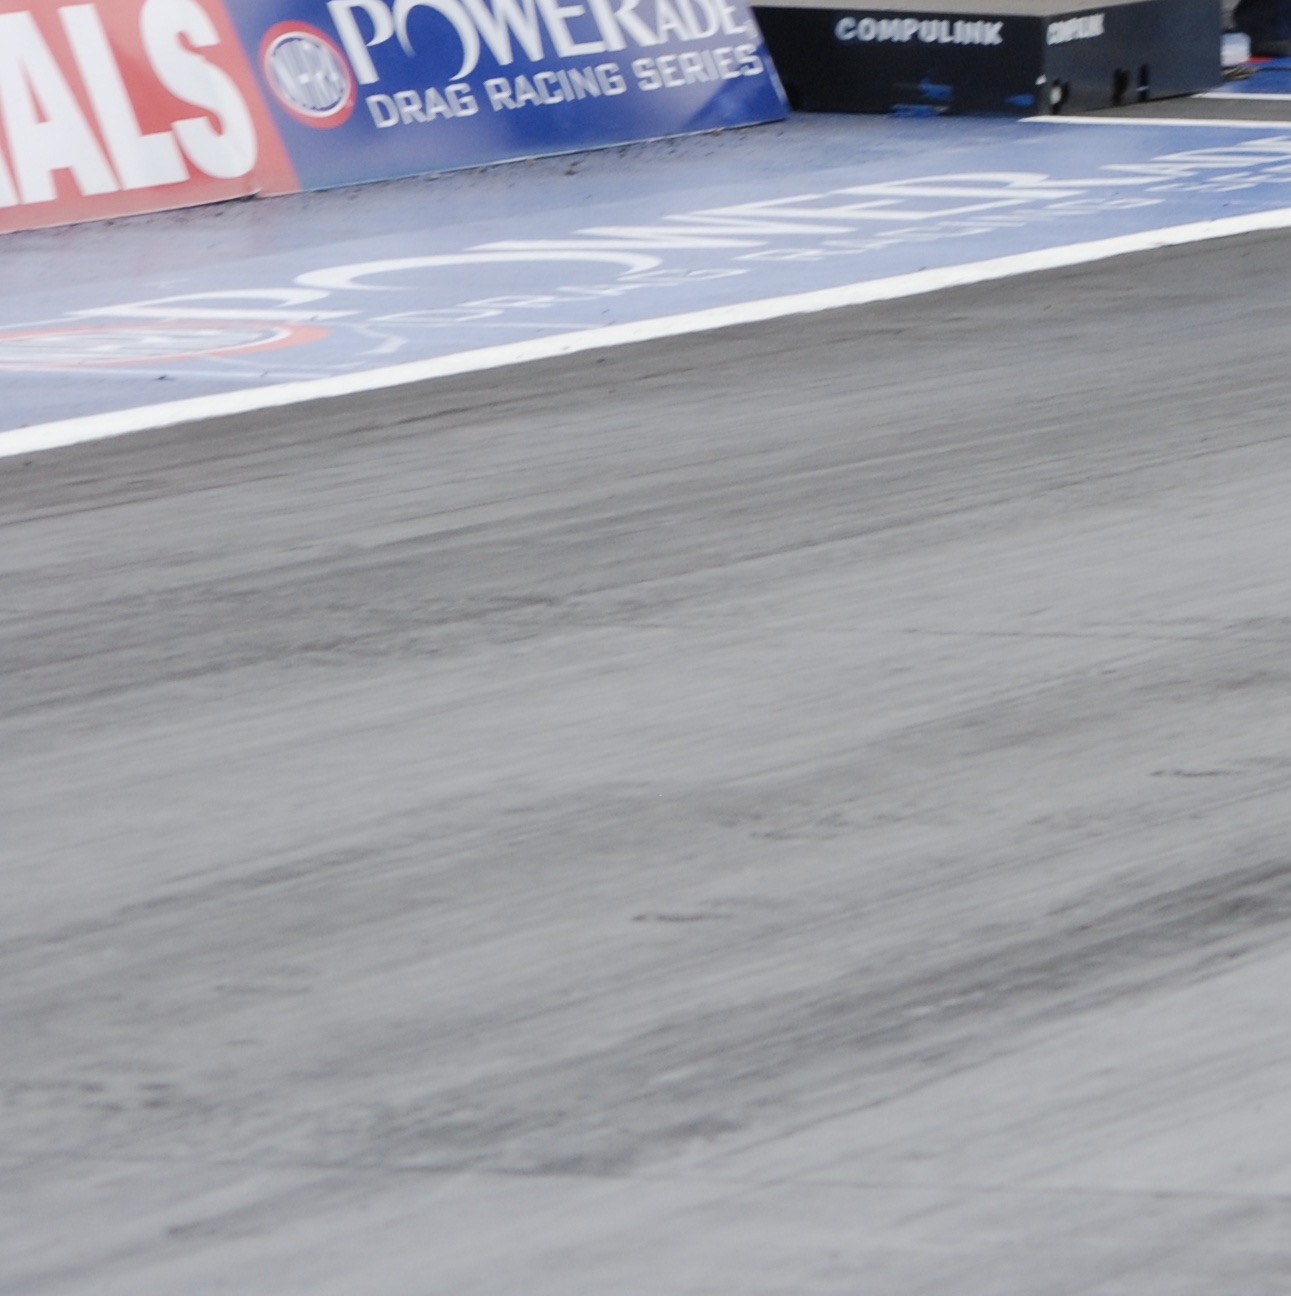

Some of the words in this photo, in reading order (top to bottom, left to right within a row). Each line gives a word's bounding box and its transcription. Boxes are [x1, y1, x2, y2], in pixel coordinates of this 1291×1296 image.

[834, 16, 1004, 46] COMPULINK
[365, 82, 479, 129] DRAG
[484, 61, 628, 113] RACING
[631, 41, 765, 92] SERIES
